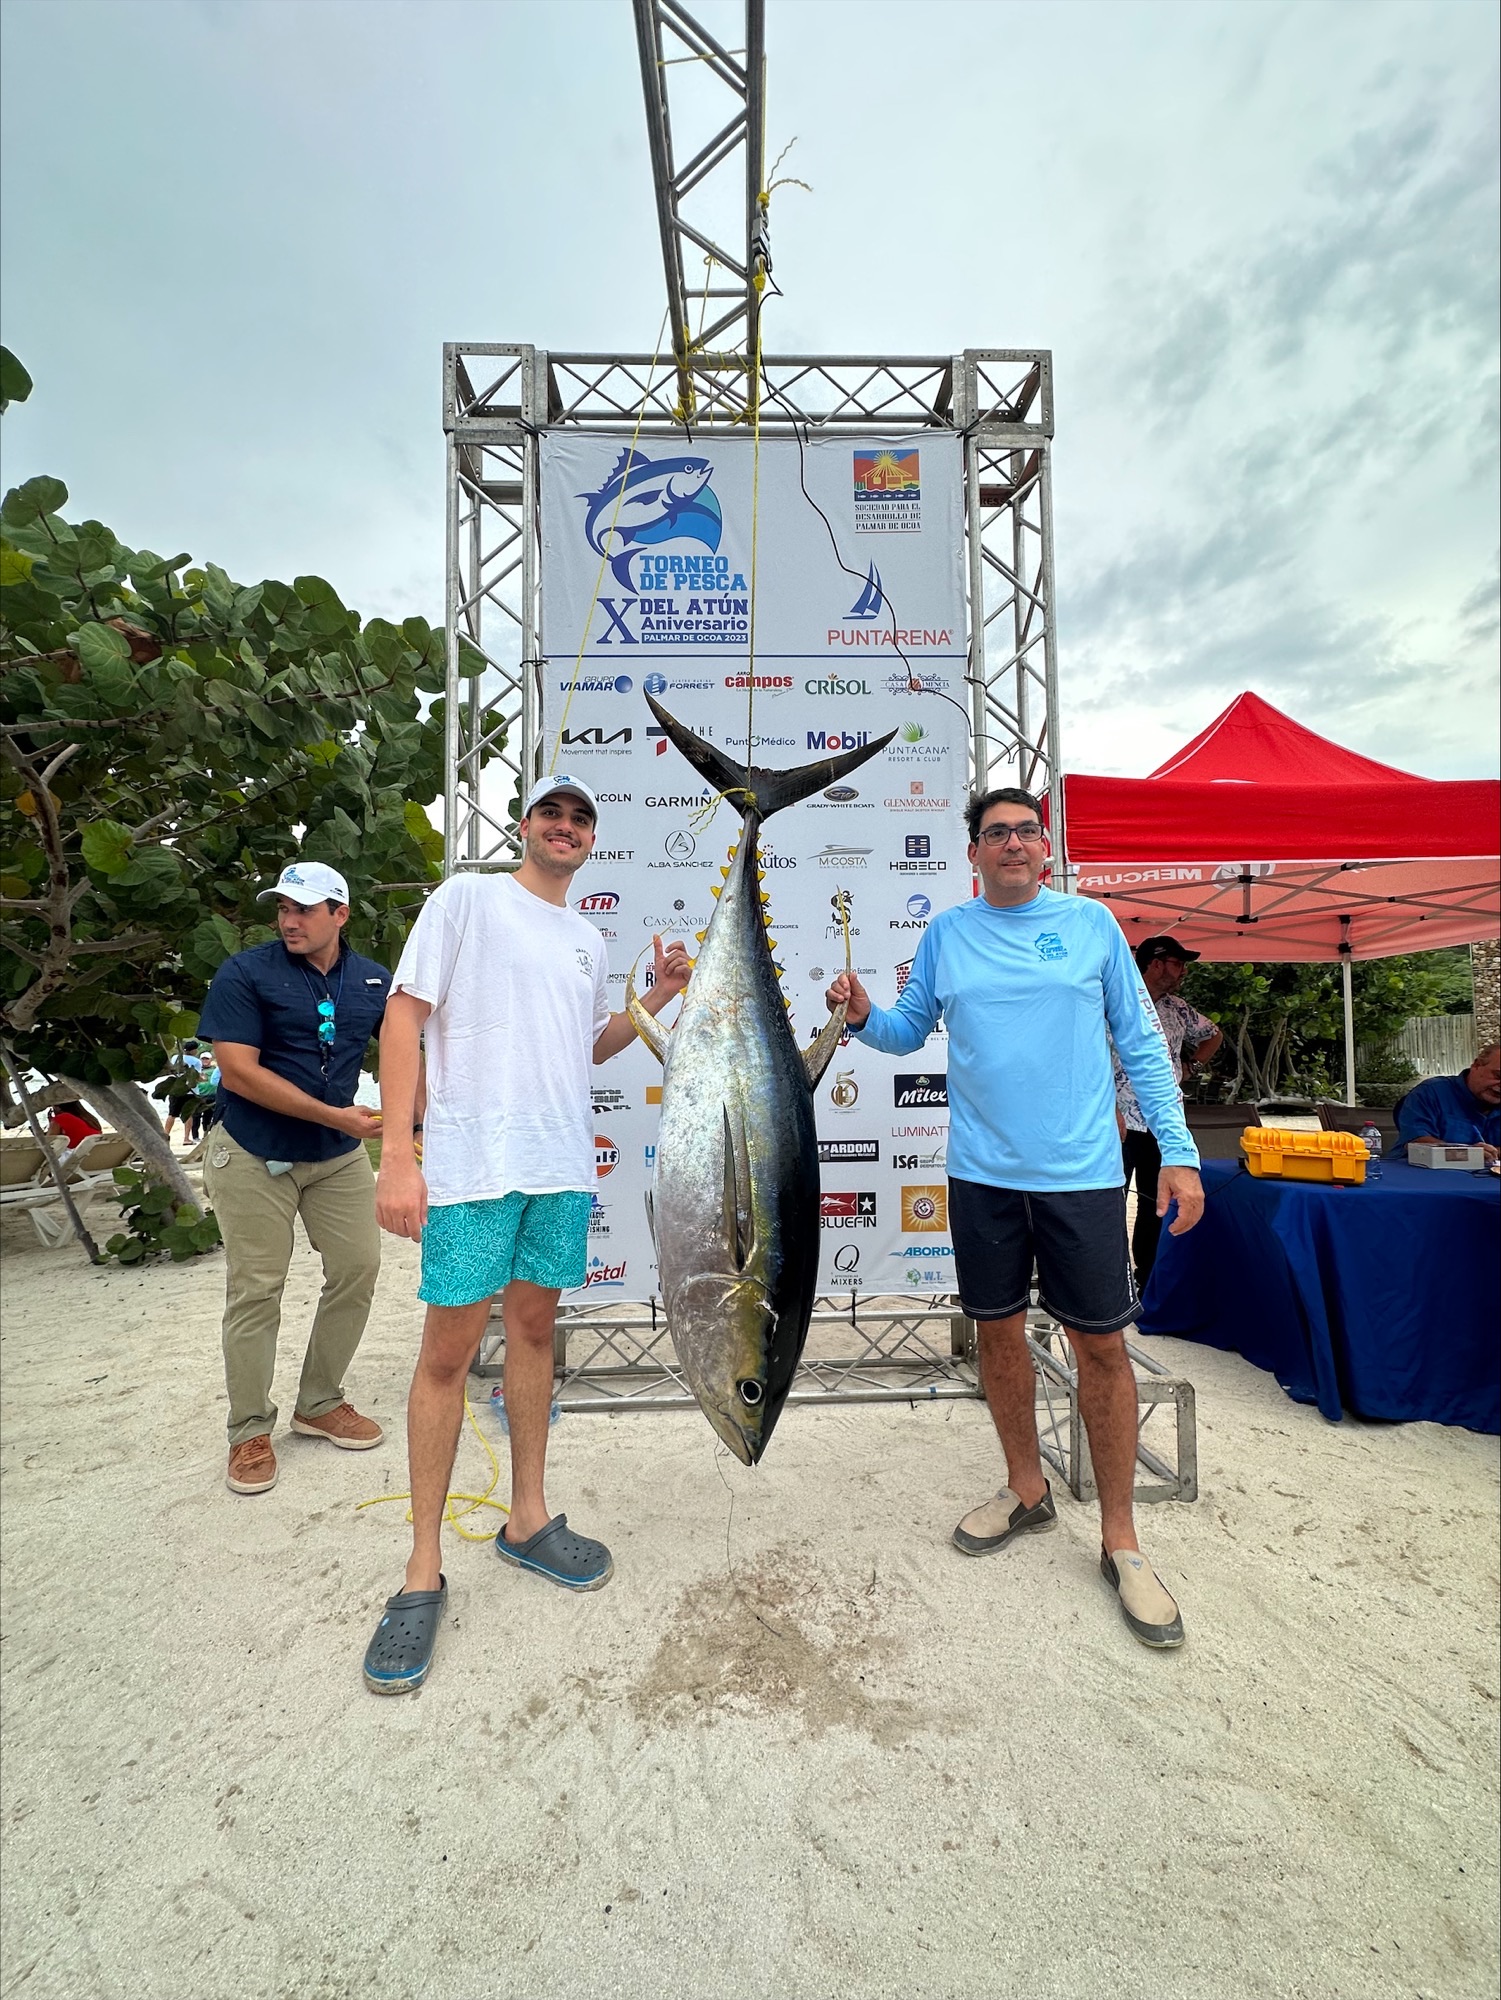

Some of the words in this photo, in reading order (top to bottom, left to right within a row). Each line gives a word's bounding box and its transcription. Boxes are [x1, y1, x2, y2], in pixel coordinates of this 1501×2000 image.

[891, 503, 910, 511] PARA
[911, 502, 921, 510] EL
[856, 522, 886, 530] PALMAR
[888, 522, 899, 530] DE
[901, 521, 921, 529] OCOA
[640, 555, 728, 573] TORNEO
[640, 573, 668, 591] DE
[674, 573, 748, 591] PESCA
[640, 598, 679, 615] DEL
[687, 593, 748, 615] ATÚN
[596, 598, 640, 644] X
[641, 616, 748, 631] Aniversario
[644, 634, 681, 642] PALMAR
[683, 634, 695, 642] DE
[698, 634, 723, 642] OCOA
[724, 634, 747, 642] 2023
[827, 630, 952, 646] PUNTARENA
[560, 682, 613, 691] VIAMAR
[724, 676, 793, 688] campos
[805, 680, 872, 695] CRISOL
[561, 727, 632, 744] KIA
[807, 731, 868, 750] Mobil
[882, 746, 947, 755] PUNTACANA
[594, 793, 632, 803] NCOLN
[645, 796, 712, 808] GARMIN
[883, 798, 951, 808] GLENMORANGIE
[589, 850, 635, 860] HENET
[580, 897, 613, 910] LTH
[643, 916, 675, 928] CASA
[679, 916, 709, 926] NOBL
[889, 920, 929, 929] RANN
[825, 925, 861, 940] Matde
[898, 1089, 947, 1106] Milex
[891, 1126, 949, 1137] LUMINAT
[596, 1150, 617, 1162] lf
[893, 1155, 918, 1169] ISA
[820, 1217, 876, 1228] BLUEFIN
[834, 1244, 860, 1272] Q
[582, 1260, 627, 1289] ystal
[924, 1272, 943, 1281] W.T.
